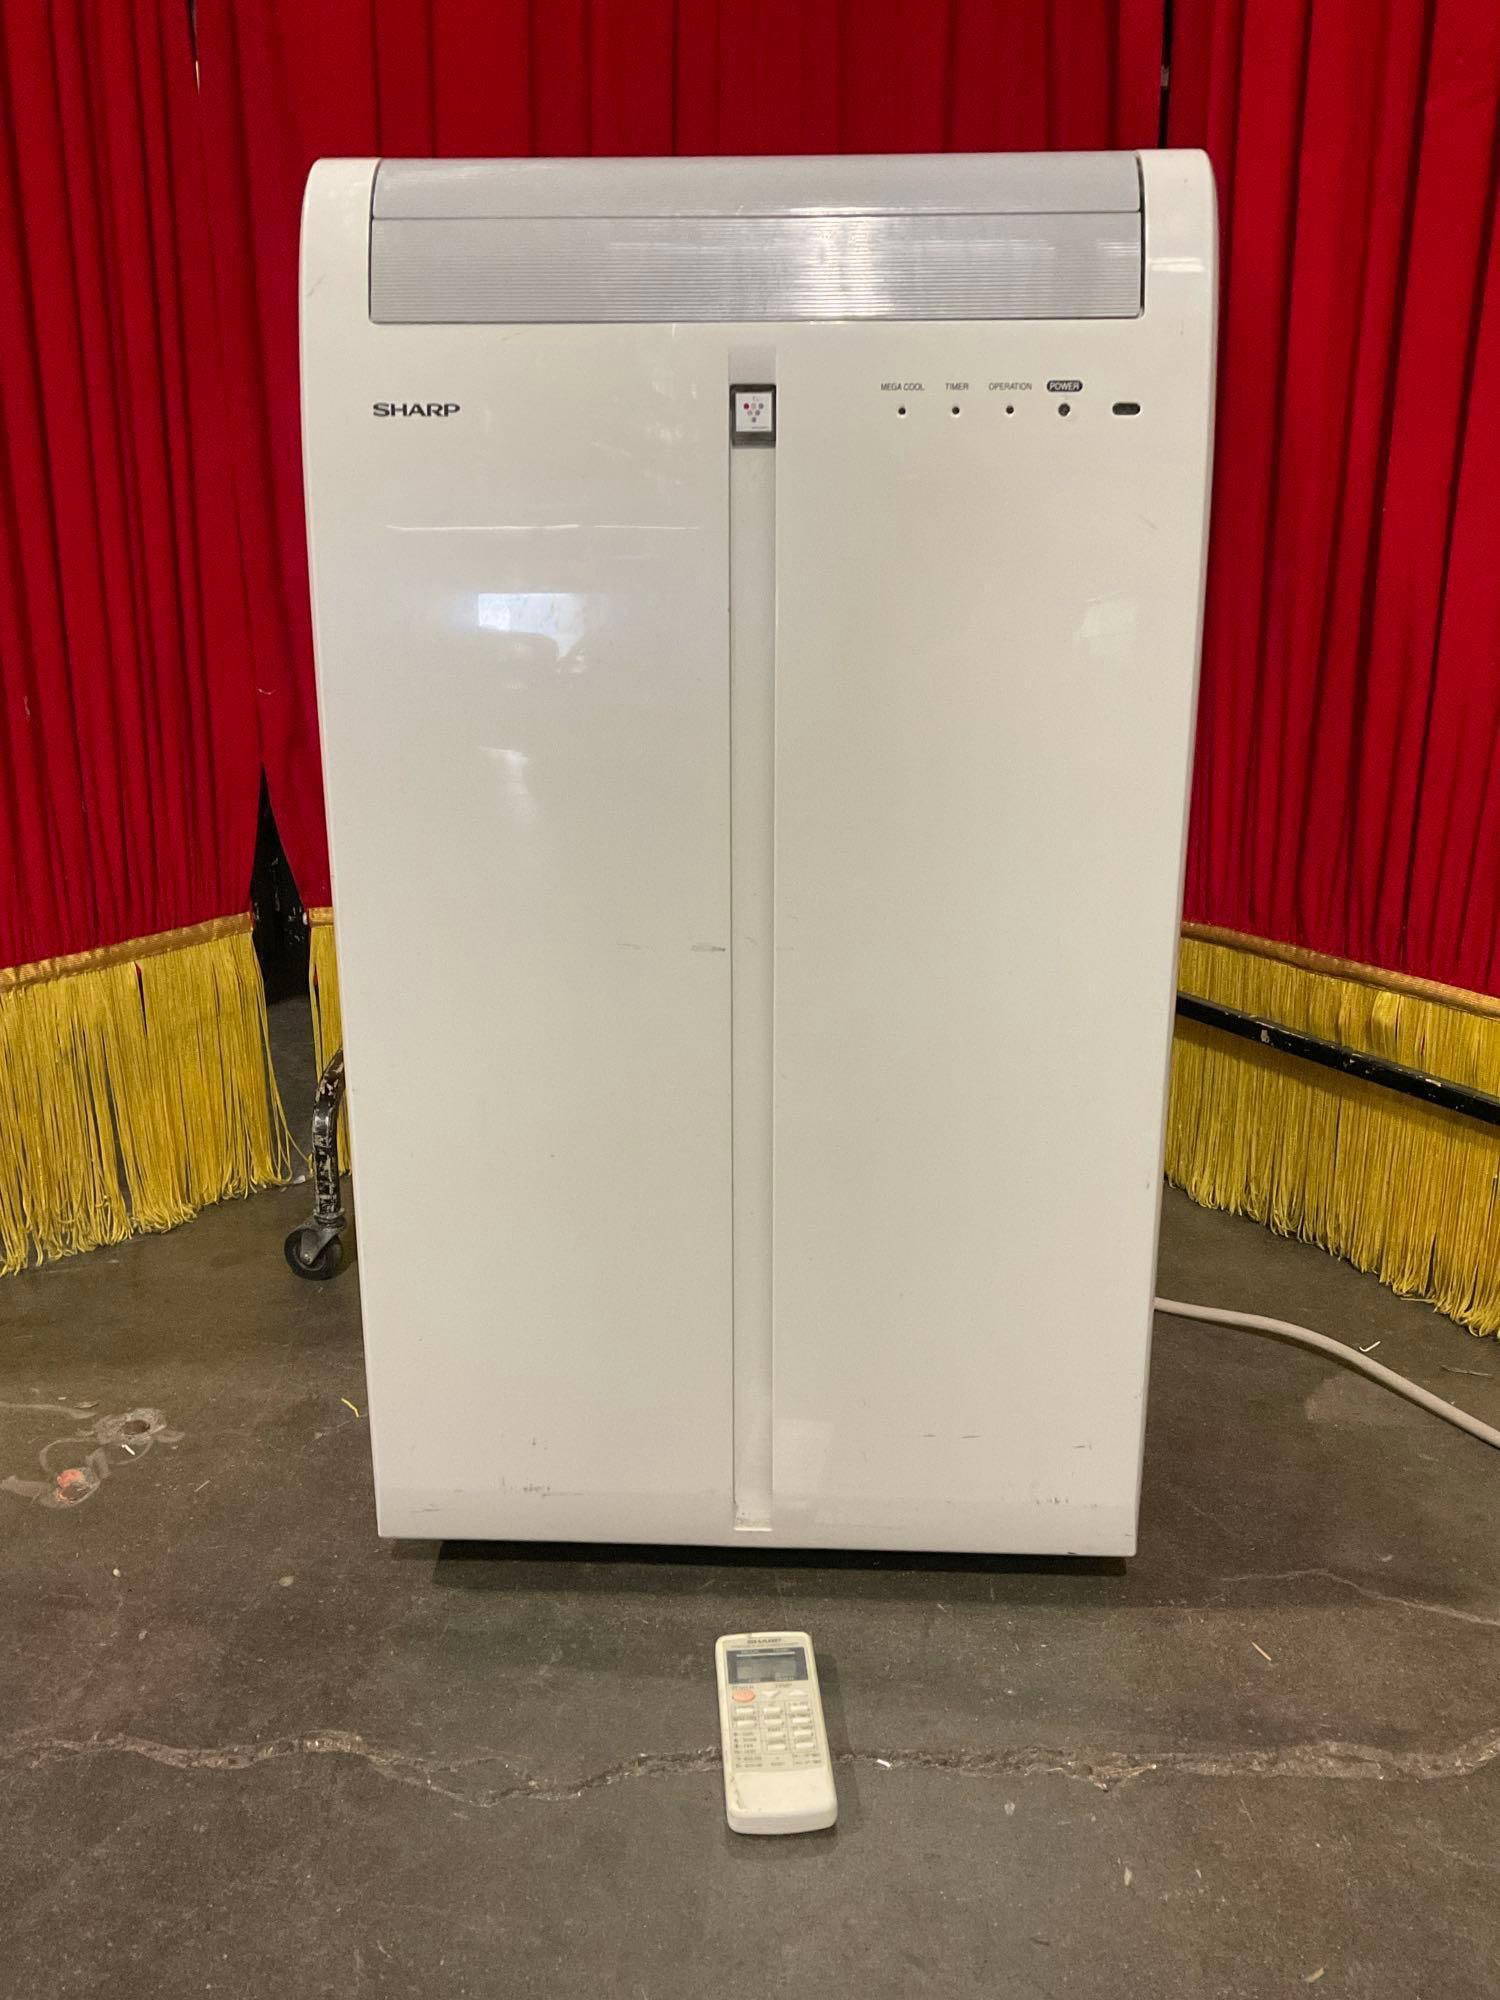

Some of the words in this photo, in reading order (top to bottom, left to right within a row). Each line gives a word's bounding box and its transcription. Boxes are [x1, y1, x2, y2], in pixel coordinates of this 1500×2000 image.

[880, 382, 902, 391] MEGA
[903, 382, 925, 391] COOL
[945, 382, 969, 391] TIMER
[988, 382, 1032, 391] OPERATION
[1048, 382, 1080, 391] POWER
[372, 402, 461, 417] SHARP
